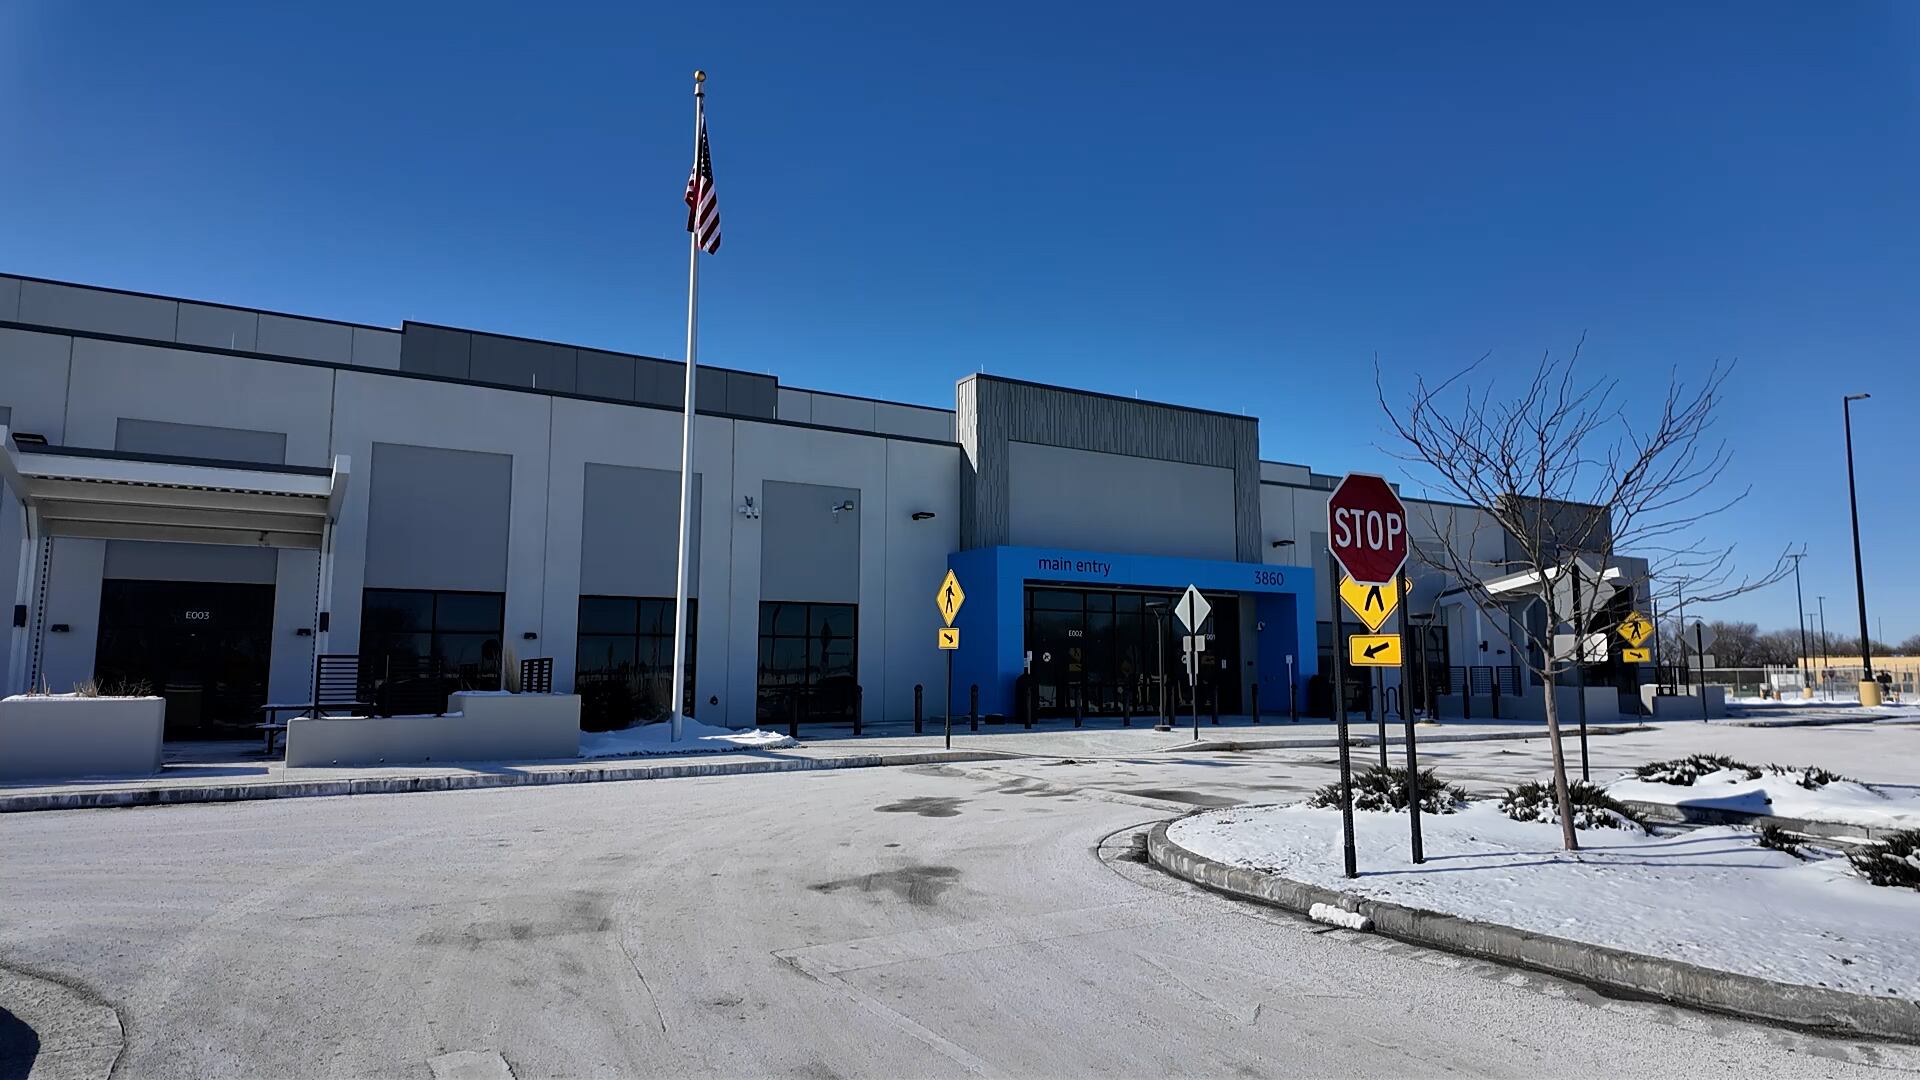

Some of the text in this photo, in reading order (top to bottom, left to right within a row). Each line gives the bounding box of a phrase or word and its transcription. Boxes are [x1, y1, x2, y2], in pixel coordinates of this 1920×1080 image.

[1335, 507, 1402, 551] STOP
[1039, 557, 1111, 577] main entry
[1255, 570, 1284, 586] 3860
[185, 611, 210, 620] E003
